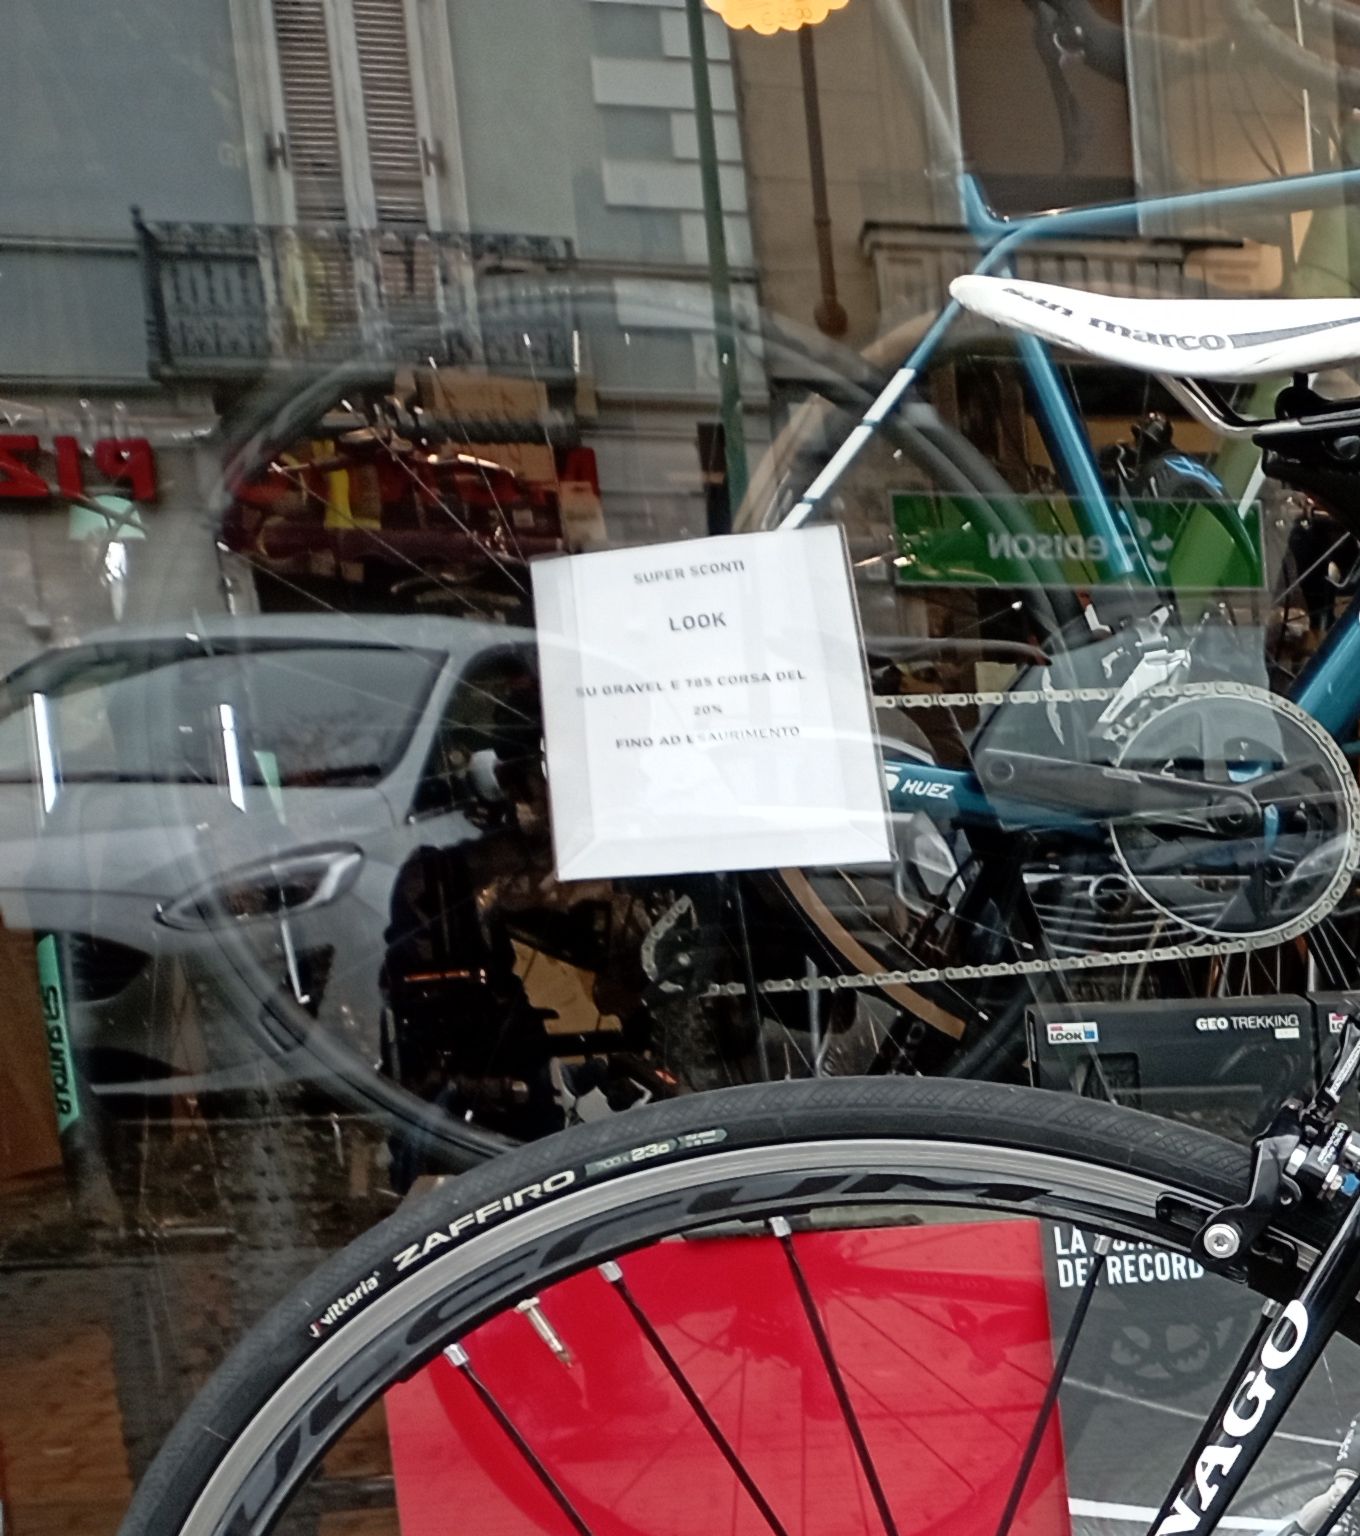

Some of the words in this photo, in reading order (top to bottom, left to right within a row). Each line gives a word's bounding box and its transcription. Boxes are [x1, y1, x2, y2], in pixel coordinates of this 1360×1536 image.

[1088, 317, 1226, 351] marco
[633, 566, 686, 585] SUPER
[690, 559, 746, 578] SCONTI
[668, 612, 727, 632] LOOK
[575, 685, 598, 699] SU
[602, 680, 666, 698] GRAVEL
[671, 679, 681, 691] E
[718, 671, 772, 688] CORSA
[776, 667, 807, 683] DEL
[693, 703, 723, 717] 20%
[615, 736, 654, 750] FINO
[659, 734, 682, 746] AD
[685, 725, 801, 745] ESAURIMENTO
[900, 778, 954, 799] HUEZ
[1196, 1017, 1229, 1031] GEO
[1230, 1014, 1300, 1029] TREKKING
[1050, 1031, 1082, 1041] LOOK
[321, 1270, 381, 1325] vittoria
[392, 1168, 577, 1272] ZAFFIRO
[1053, 1225, 1088, 1255] LA
[1106, 1253, 1206, 1286] RECORD
